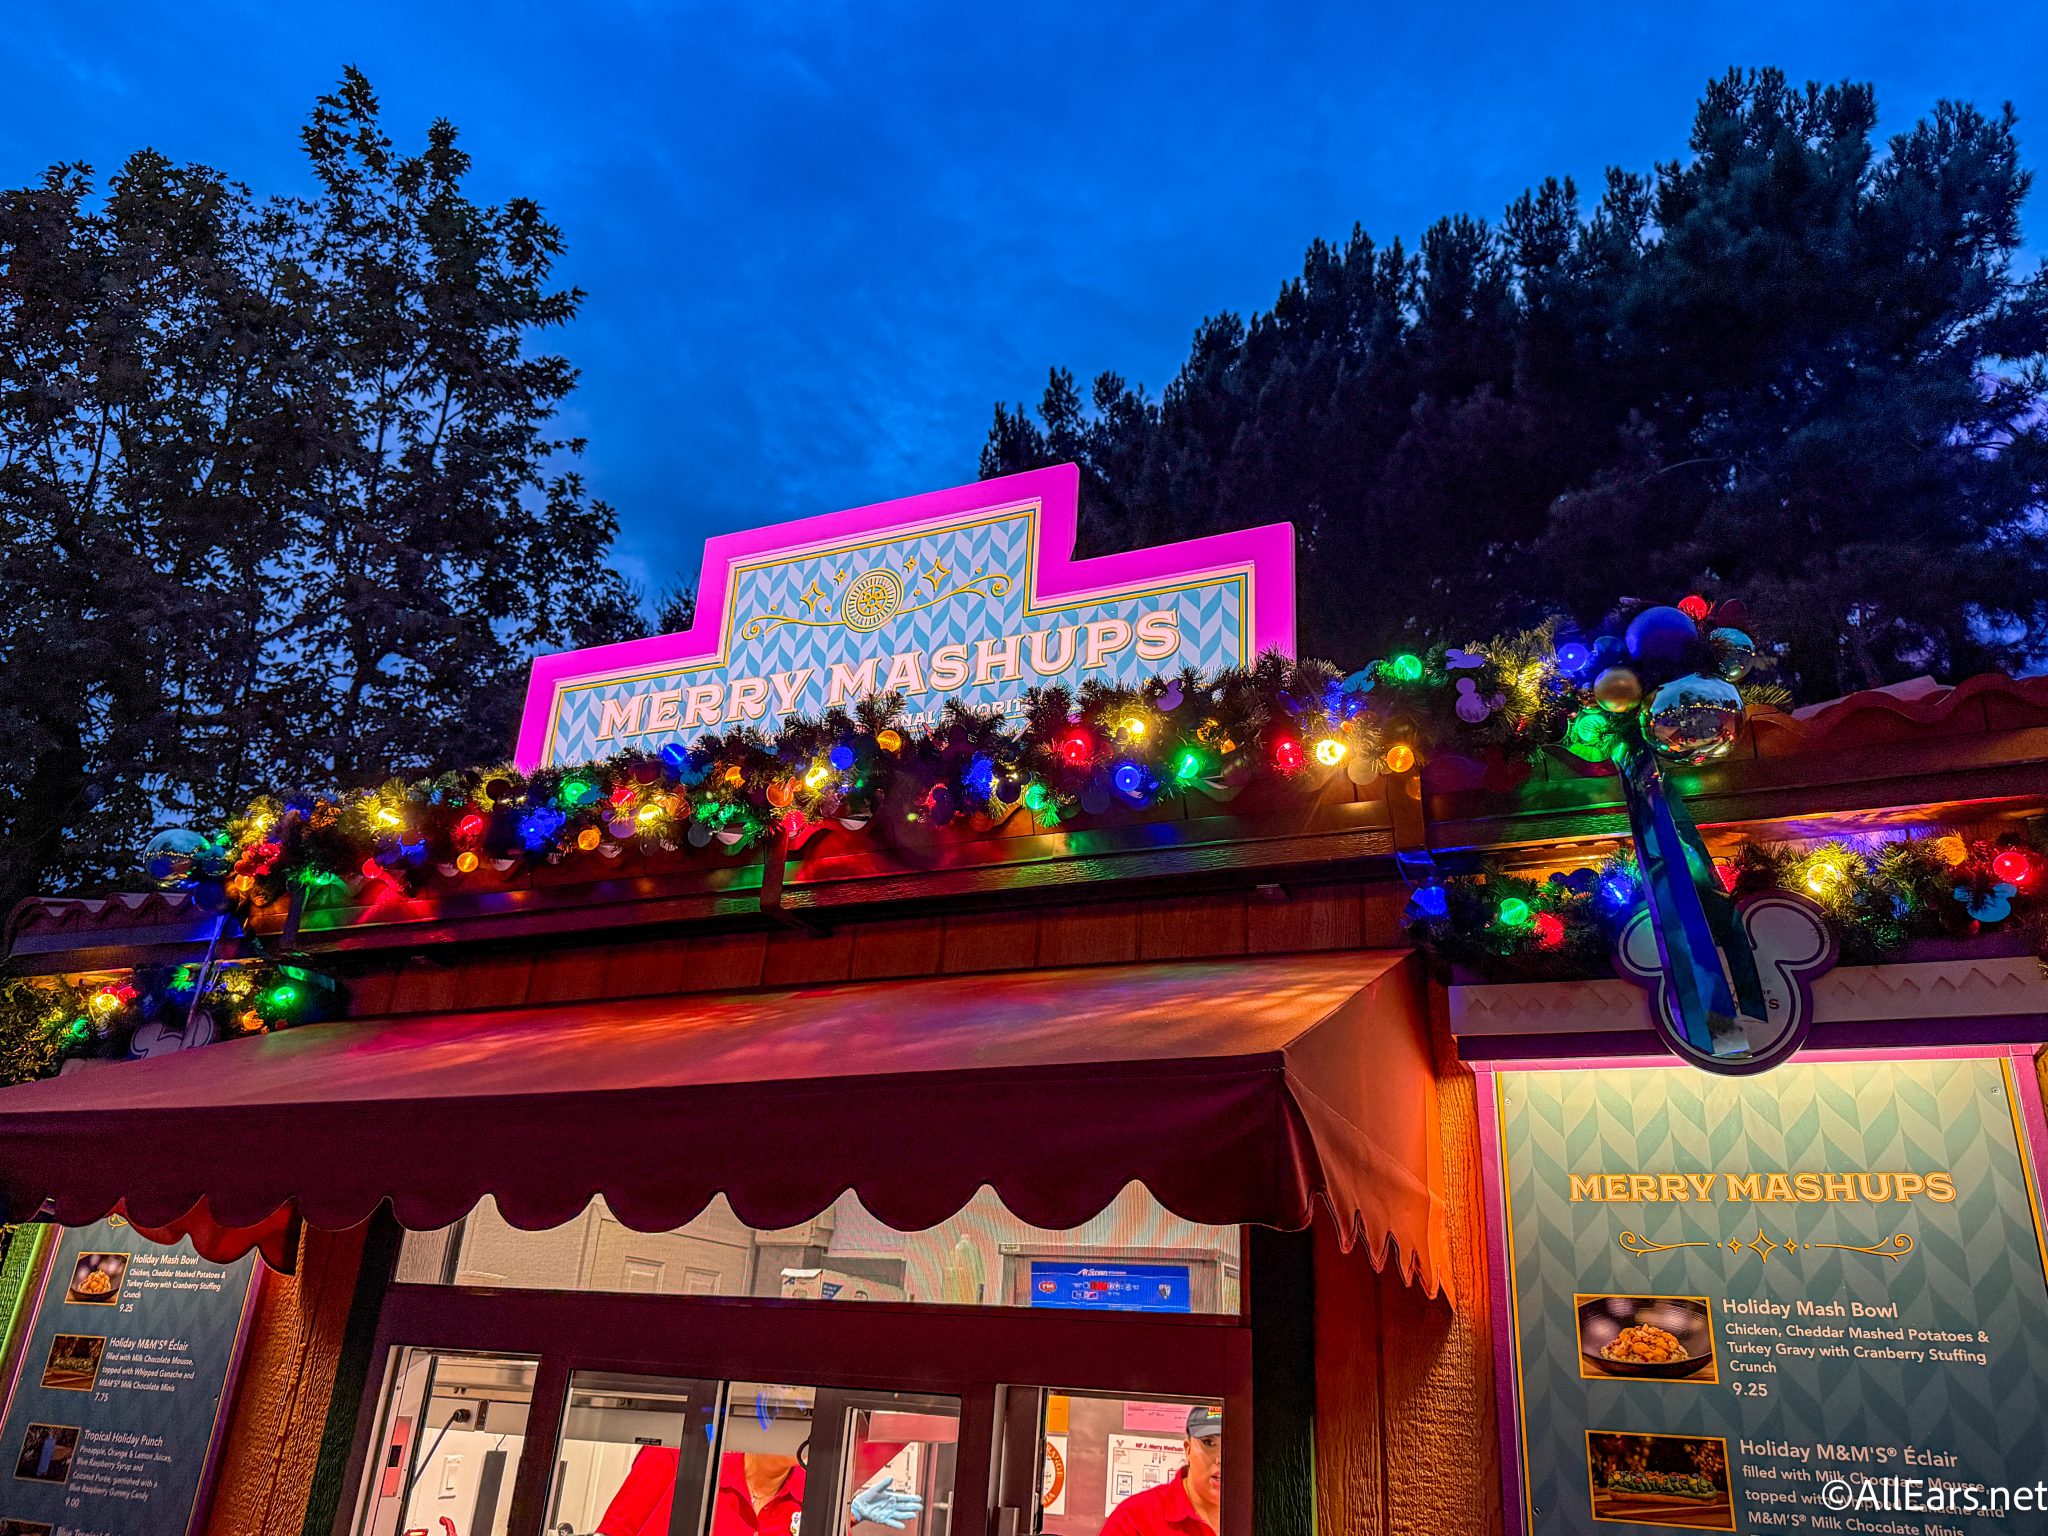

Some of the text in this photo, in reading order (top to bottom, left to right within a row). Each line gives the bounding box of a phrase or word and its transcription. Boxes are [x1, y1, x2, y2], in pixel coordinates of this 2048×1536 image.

[596, 609, 1182, 741] MERRY MASHUPS
[1567, 1172, 1957, 1203] MERRY MASHUPS
[133, 1254, 199, 1266] Holiday Mash Bowl
[129, 1268, 150, 1278] Chicken,
[152, 1269, 174, 1278] Cheddar
[175, 1270, 196, 1278] Mashed
[123, 1290, 141, 1298] Crunch
[126, 1280, 142, 1288] Turkey
[144, 1280, 160, 1290] Gravy
[172, 1282, 199, 1291] Cranberry
[200, 1282, 221, 1292] Stuffing
[120, 1304, 134, 1312] 9.25
[1723, 1299, 1898, 1319] Holiday Mash Bowl
[1725, 1324, 1990, 1344] Chicken, Cheddar Mashed Potatoes &
[109, 1337, 136, 1350] Holiday
[132, 1354, 143, 1362] Milk
[144, 1354, 170, 1364] Chocolate
[1727, 1342, 1988, 1366] Turkey Gravy with Cranberry Stuffing
[1730, 1360, 1777, 1373] Crunch
[94, 1392, 108, 1402] 7.75
[1732, 1382, 1768, 1397] 9.25
[84, 1430, 164, 1448] Tropical Holiday Punch
[1740, 1439, 1958, 1468] Holiday M&M'S® Éclair
[1742, 1465, 1776, 1479] filled
[1780, 1467, 1811, 1482] with
[1815, 1470, 1846, 1484] Milk
[1850, 1472, 1924, 1490] Chocolate
[1745, 1488, 1797, 1504] topped
[1800, 1492, 1832, 1506] with
[1976, 1504, 2006, 1519] and
[1748, 1510, 1964, 1536] M&M'S® Milk Chocolate Minis
